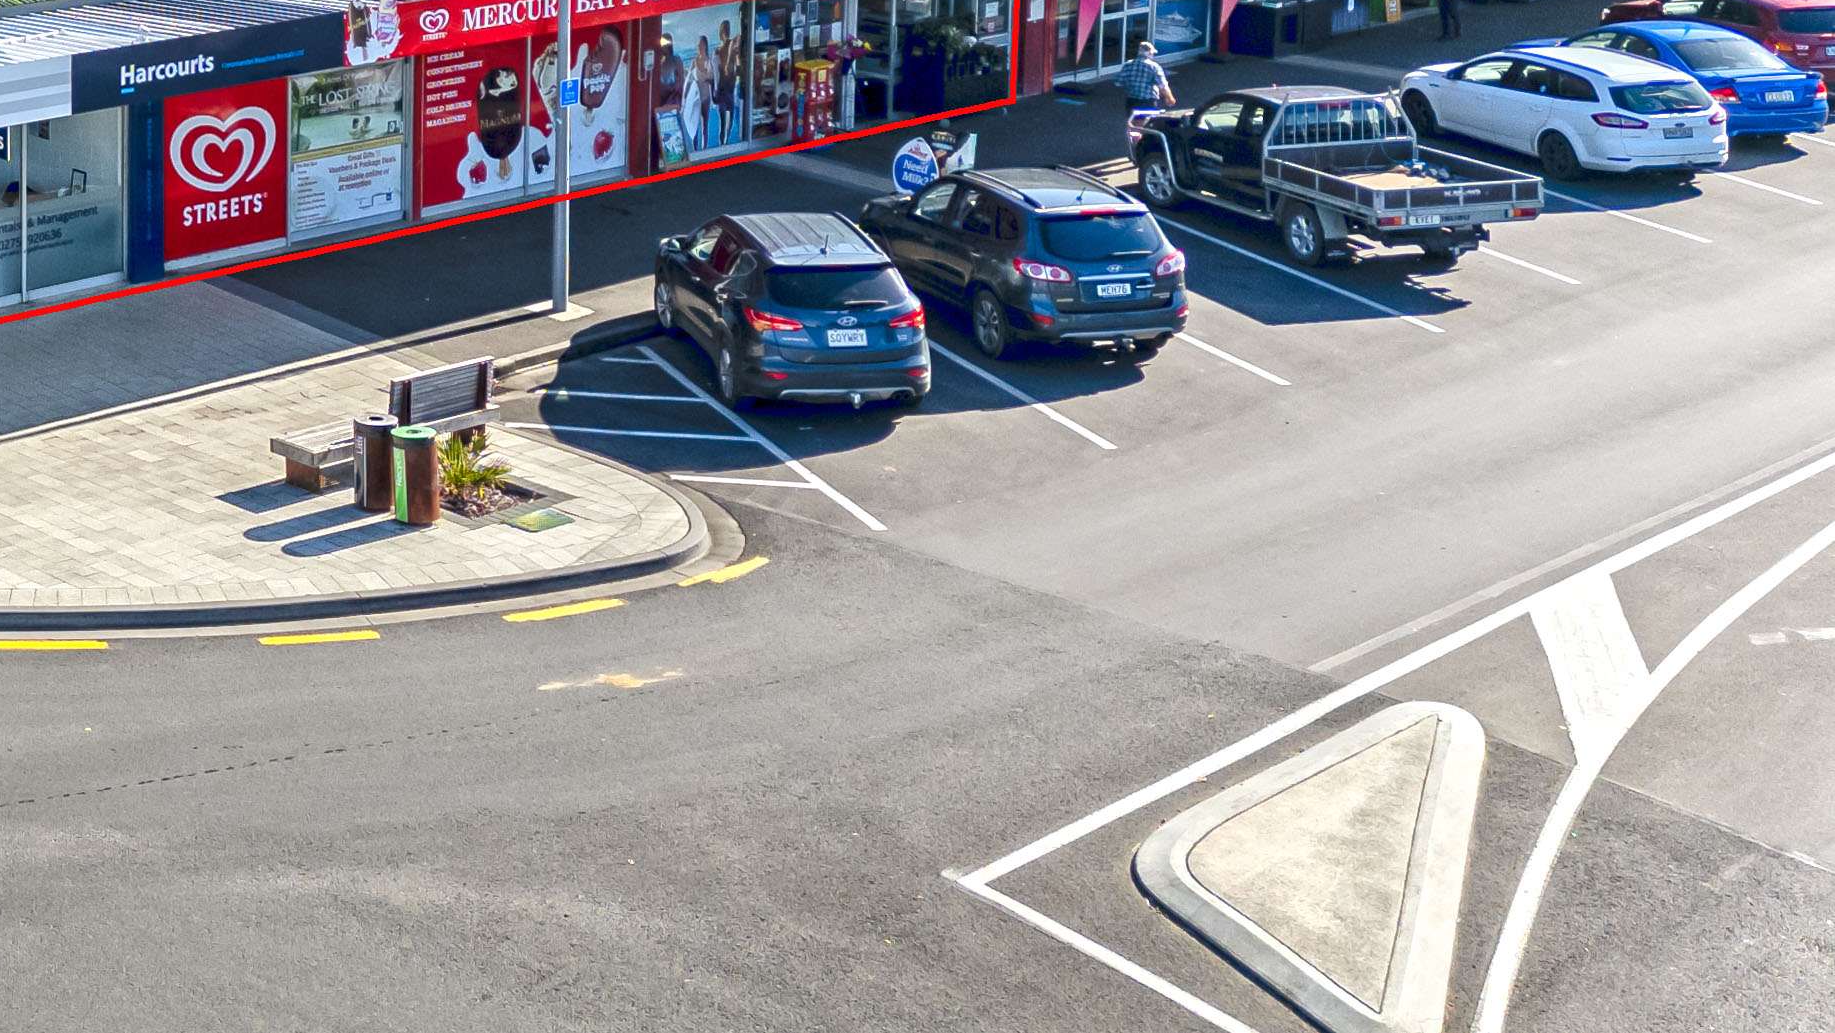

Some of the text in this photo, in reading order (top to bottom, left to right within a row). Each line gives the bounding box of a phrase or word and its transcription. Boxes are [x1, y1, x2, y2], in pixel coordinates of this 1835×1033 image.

[120, 54, 215, 86] Harcourts
[319, 88, 352, 106] LOST
[903, 159, 929, 174] Need
[36, 205, 98, 227] Management
[183, 193, 263, 227] STREETS
